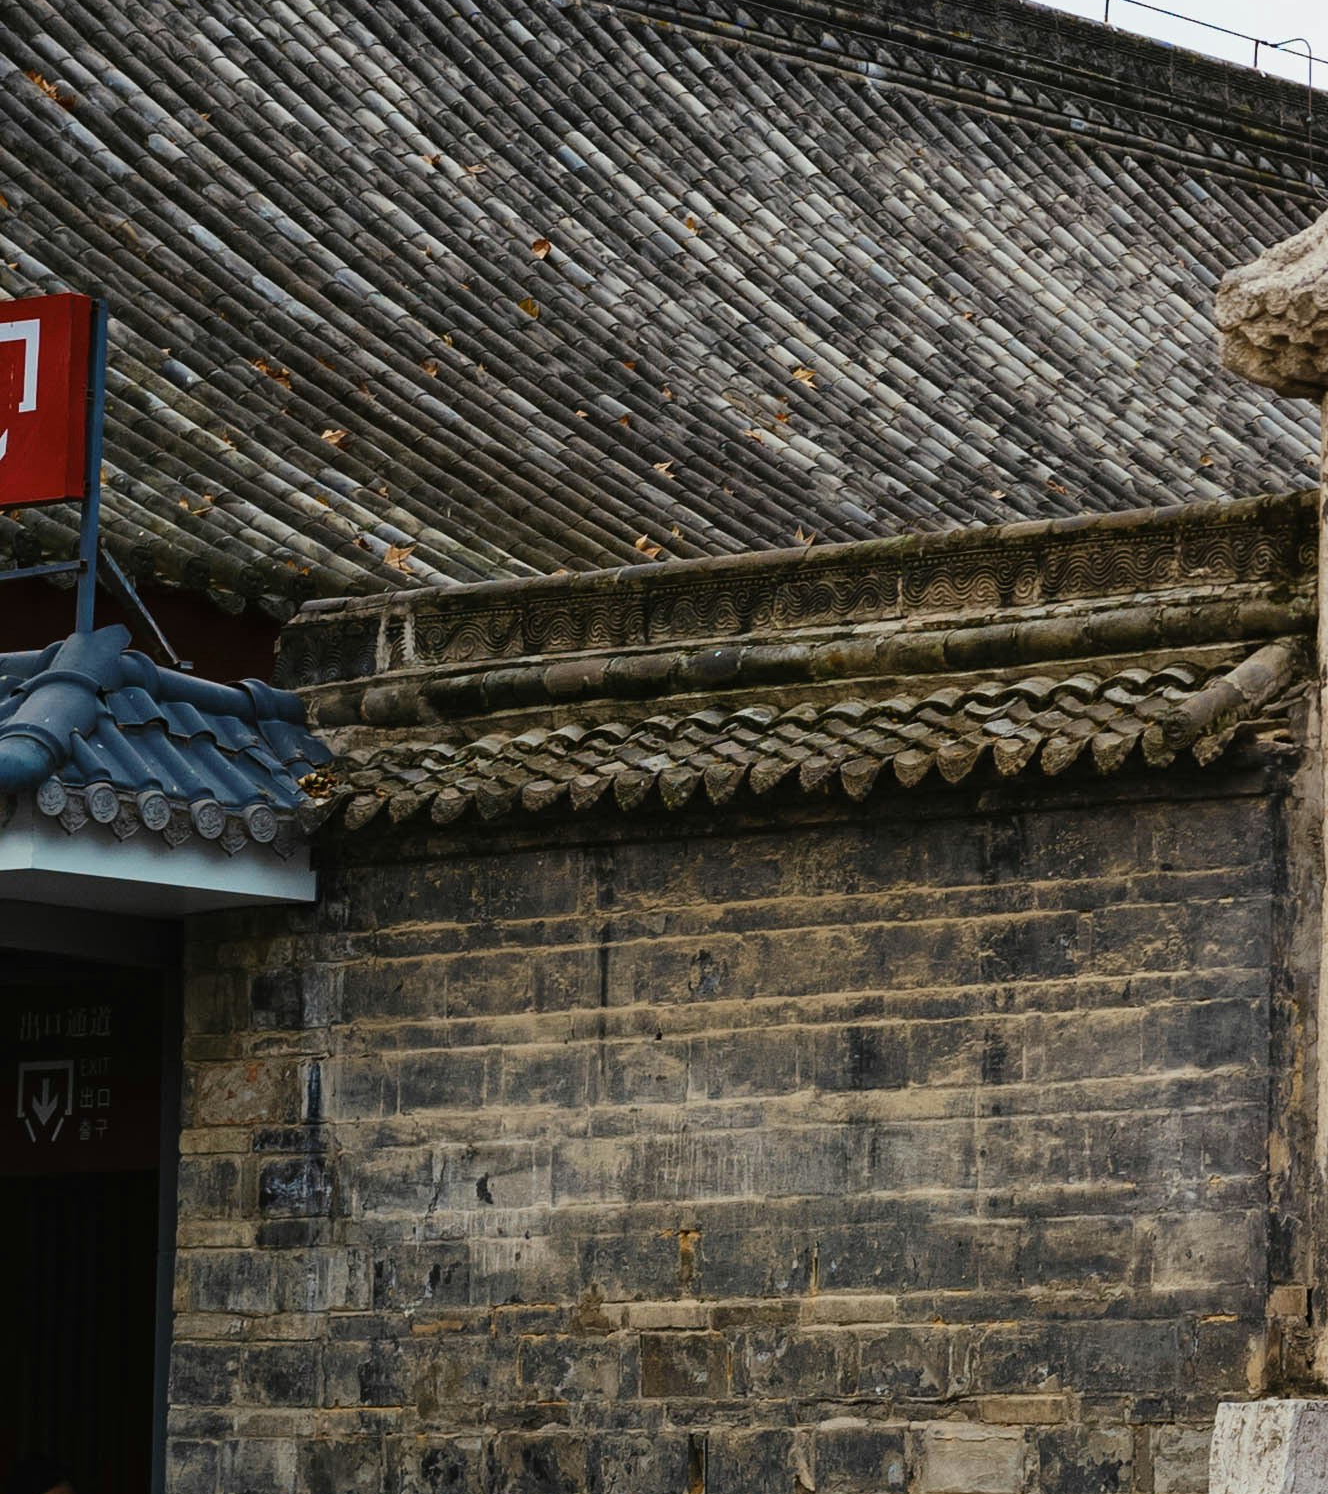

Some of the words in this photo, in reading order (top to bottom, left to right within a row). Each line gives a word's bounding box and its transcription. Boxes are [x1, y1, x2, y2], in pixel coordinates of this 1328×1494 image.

[19, 1006, 112, 1040] 出口通道
[80, 1057, 112, 1076] EXIT
[79, 1087, 111, 1108] 出口
[79, 1117, 109, 1141] 출구
